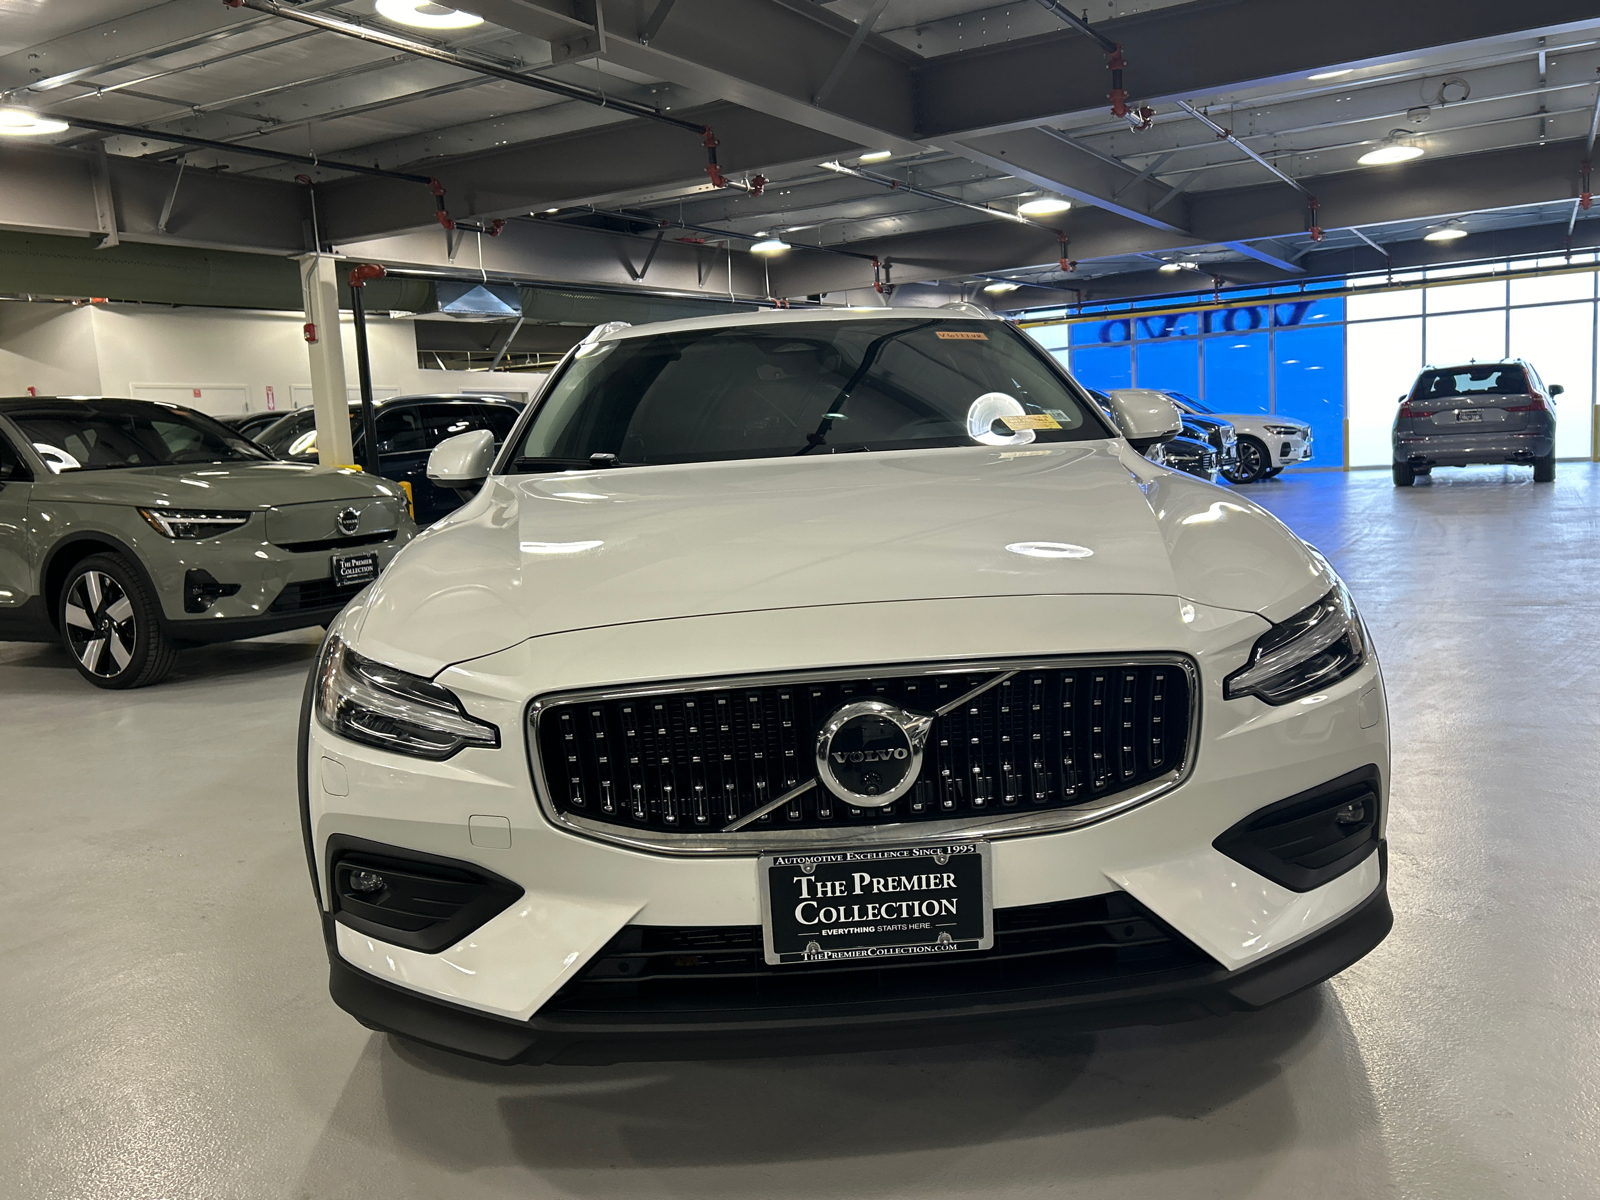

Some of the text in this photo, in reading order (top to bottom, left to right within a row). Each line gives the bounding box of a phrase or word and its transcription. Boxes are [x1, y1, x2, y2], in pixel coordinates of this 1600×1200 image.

[341, 566, 373, 575] COLLECTION
[831, 747, 908, 763] VOLVO
[776, 844, 975, 865] AUTOMOTIVE EXCELLENCE SINCE 1995
[793, 872, 958, 899] THE PREMIER
[795, 898, 958, 925] COLLECTION
[822, 922, 933, 936] EVERYTHING STARTS HERE.
